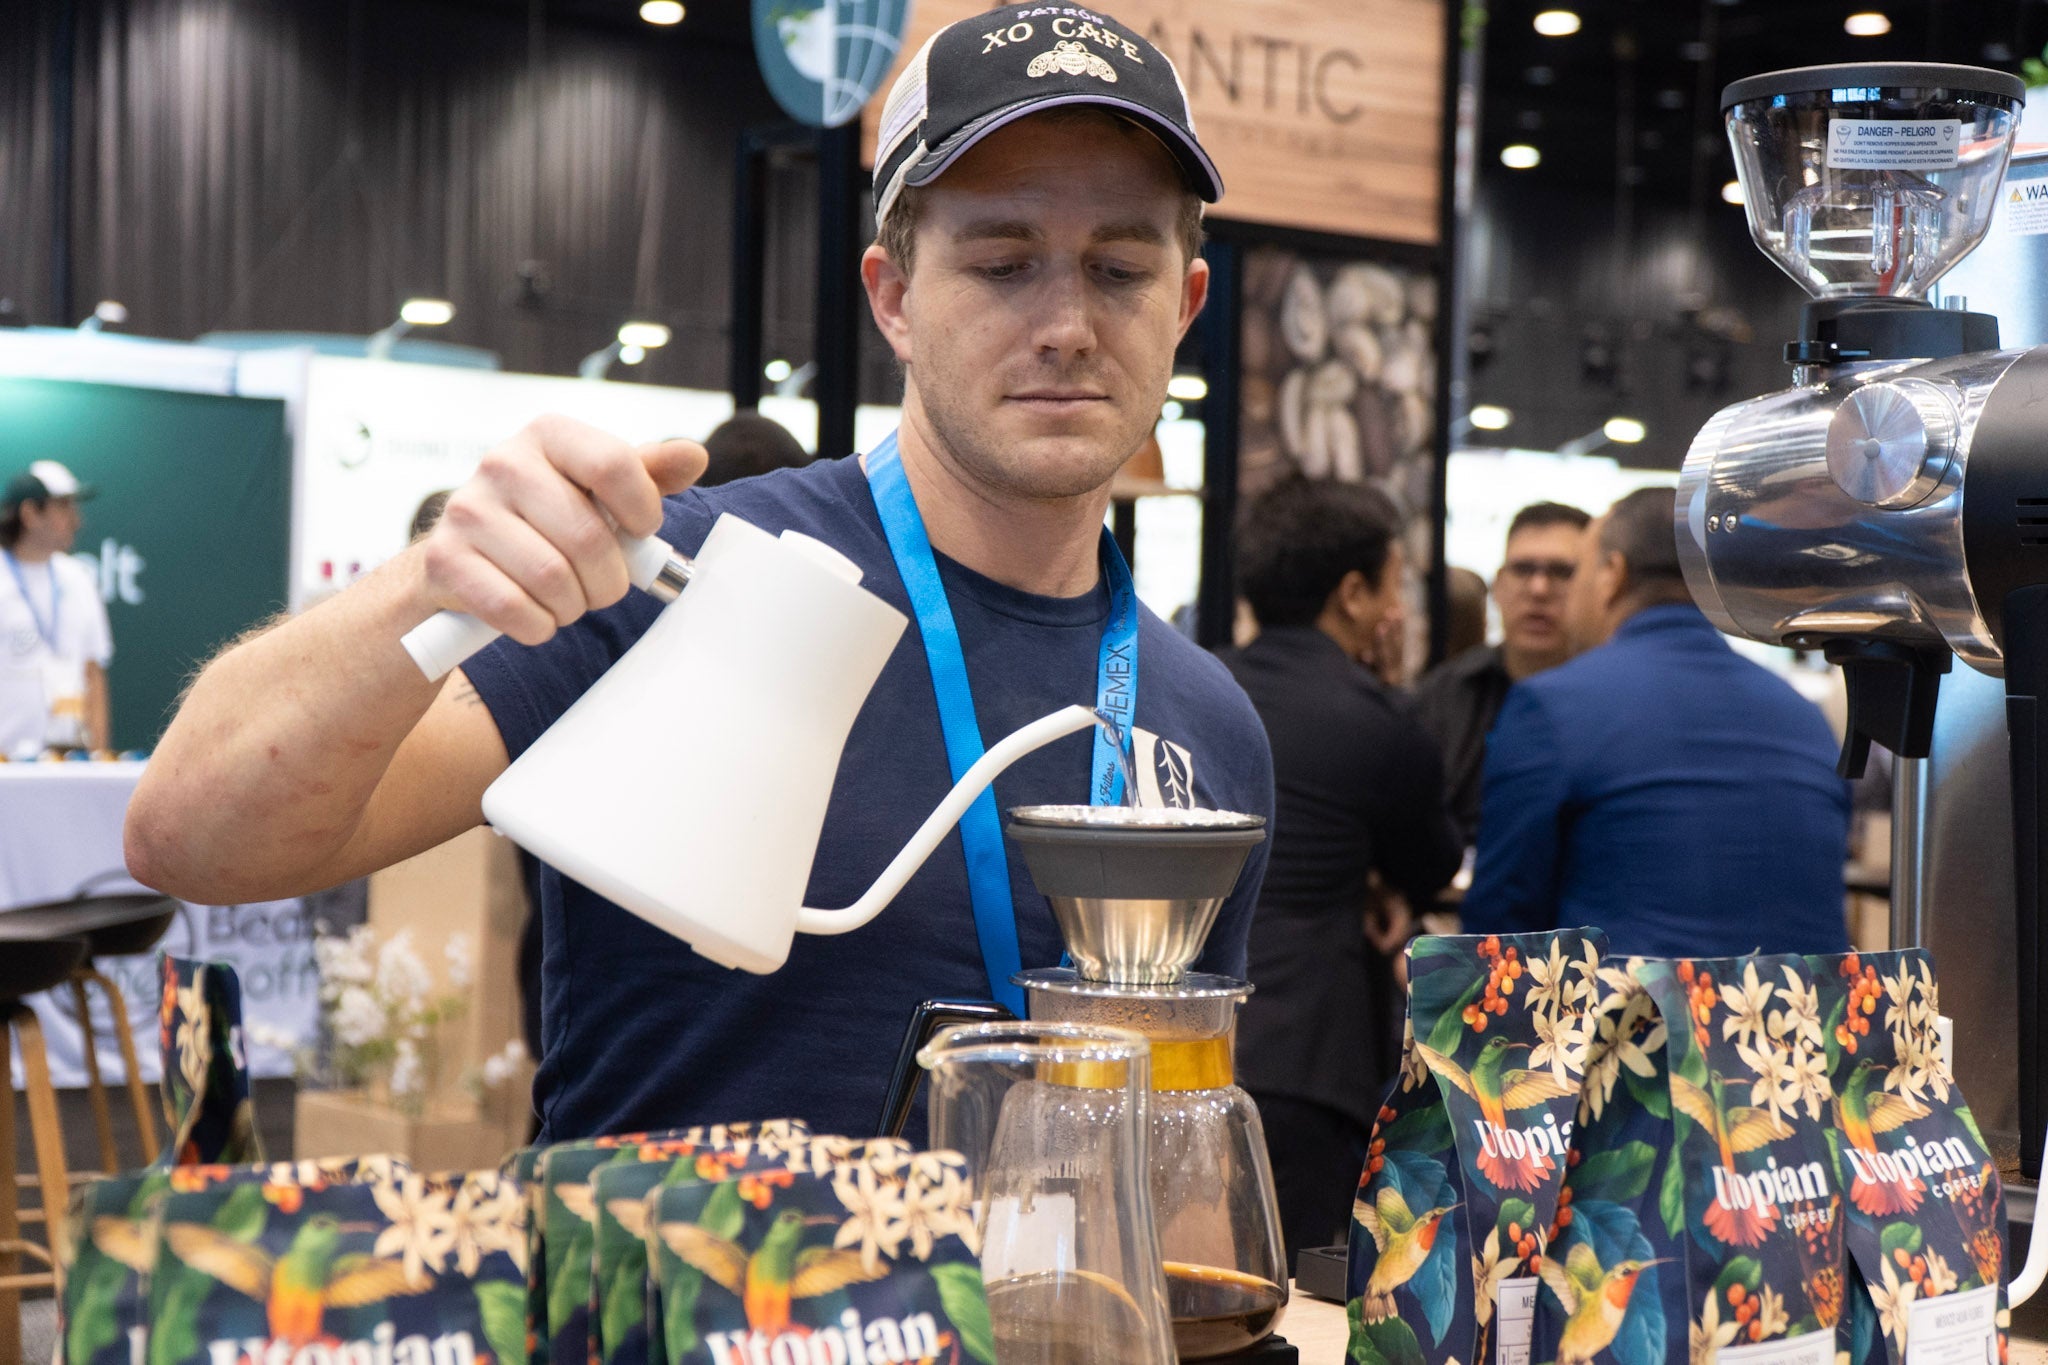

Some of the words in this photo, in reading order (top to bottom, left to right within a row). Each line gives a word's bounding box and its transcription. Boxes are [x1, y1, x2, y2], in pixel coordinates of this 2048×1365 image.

[982, 22, 1034, 54] XO
[1052, 18, 1143, 64] CAFE
[1857, 126, 1893, 137] DANGER
[1900, 126, 1936, 137] PELIGRO
[2026, 184, 2048, 200] WA
[1711, 1156, 1829, 1219] Utopian
[1844, 1135, 1976, 1191] Utopian
[705, 1307, 941, 1365] Utopian
